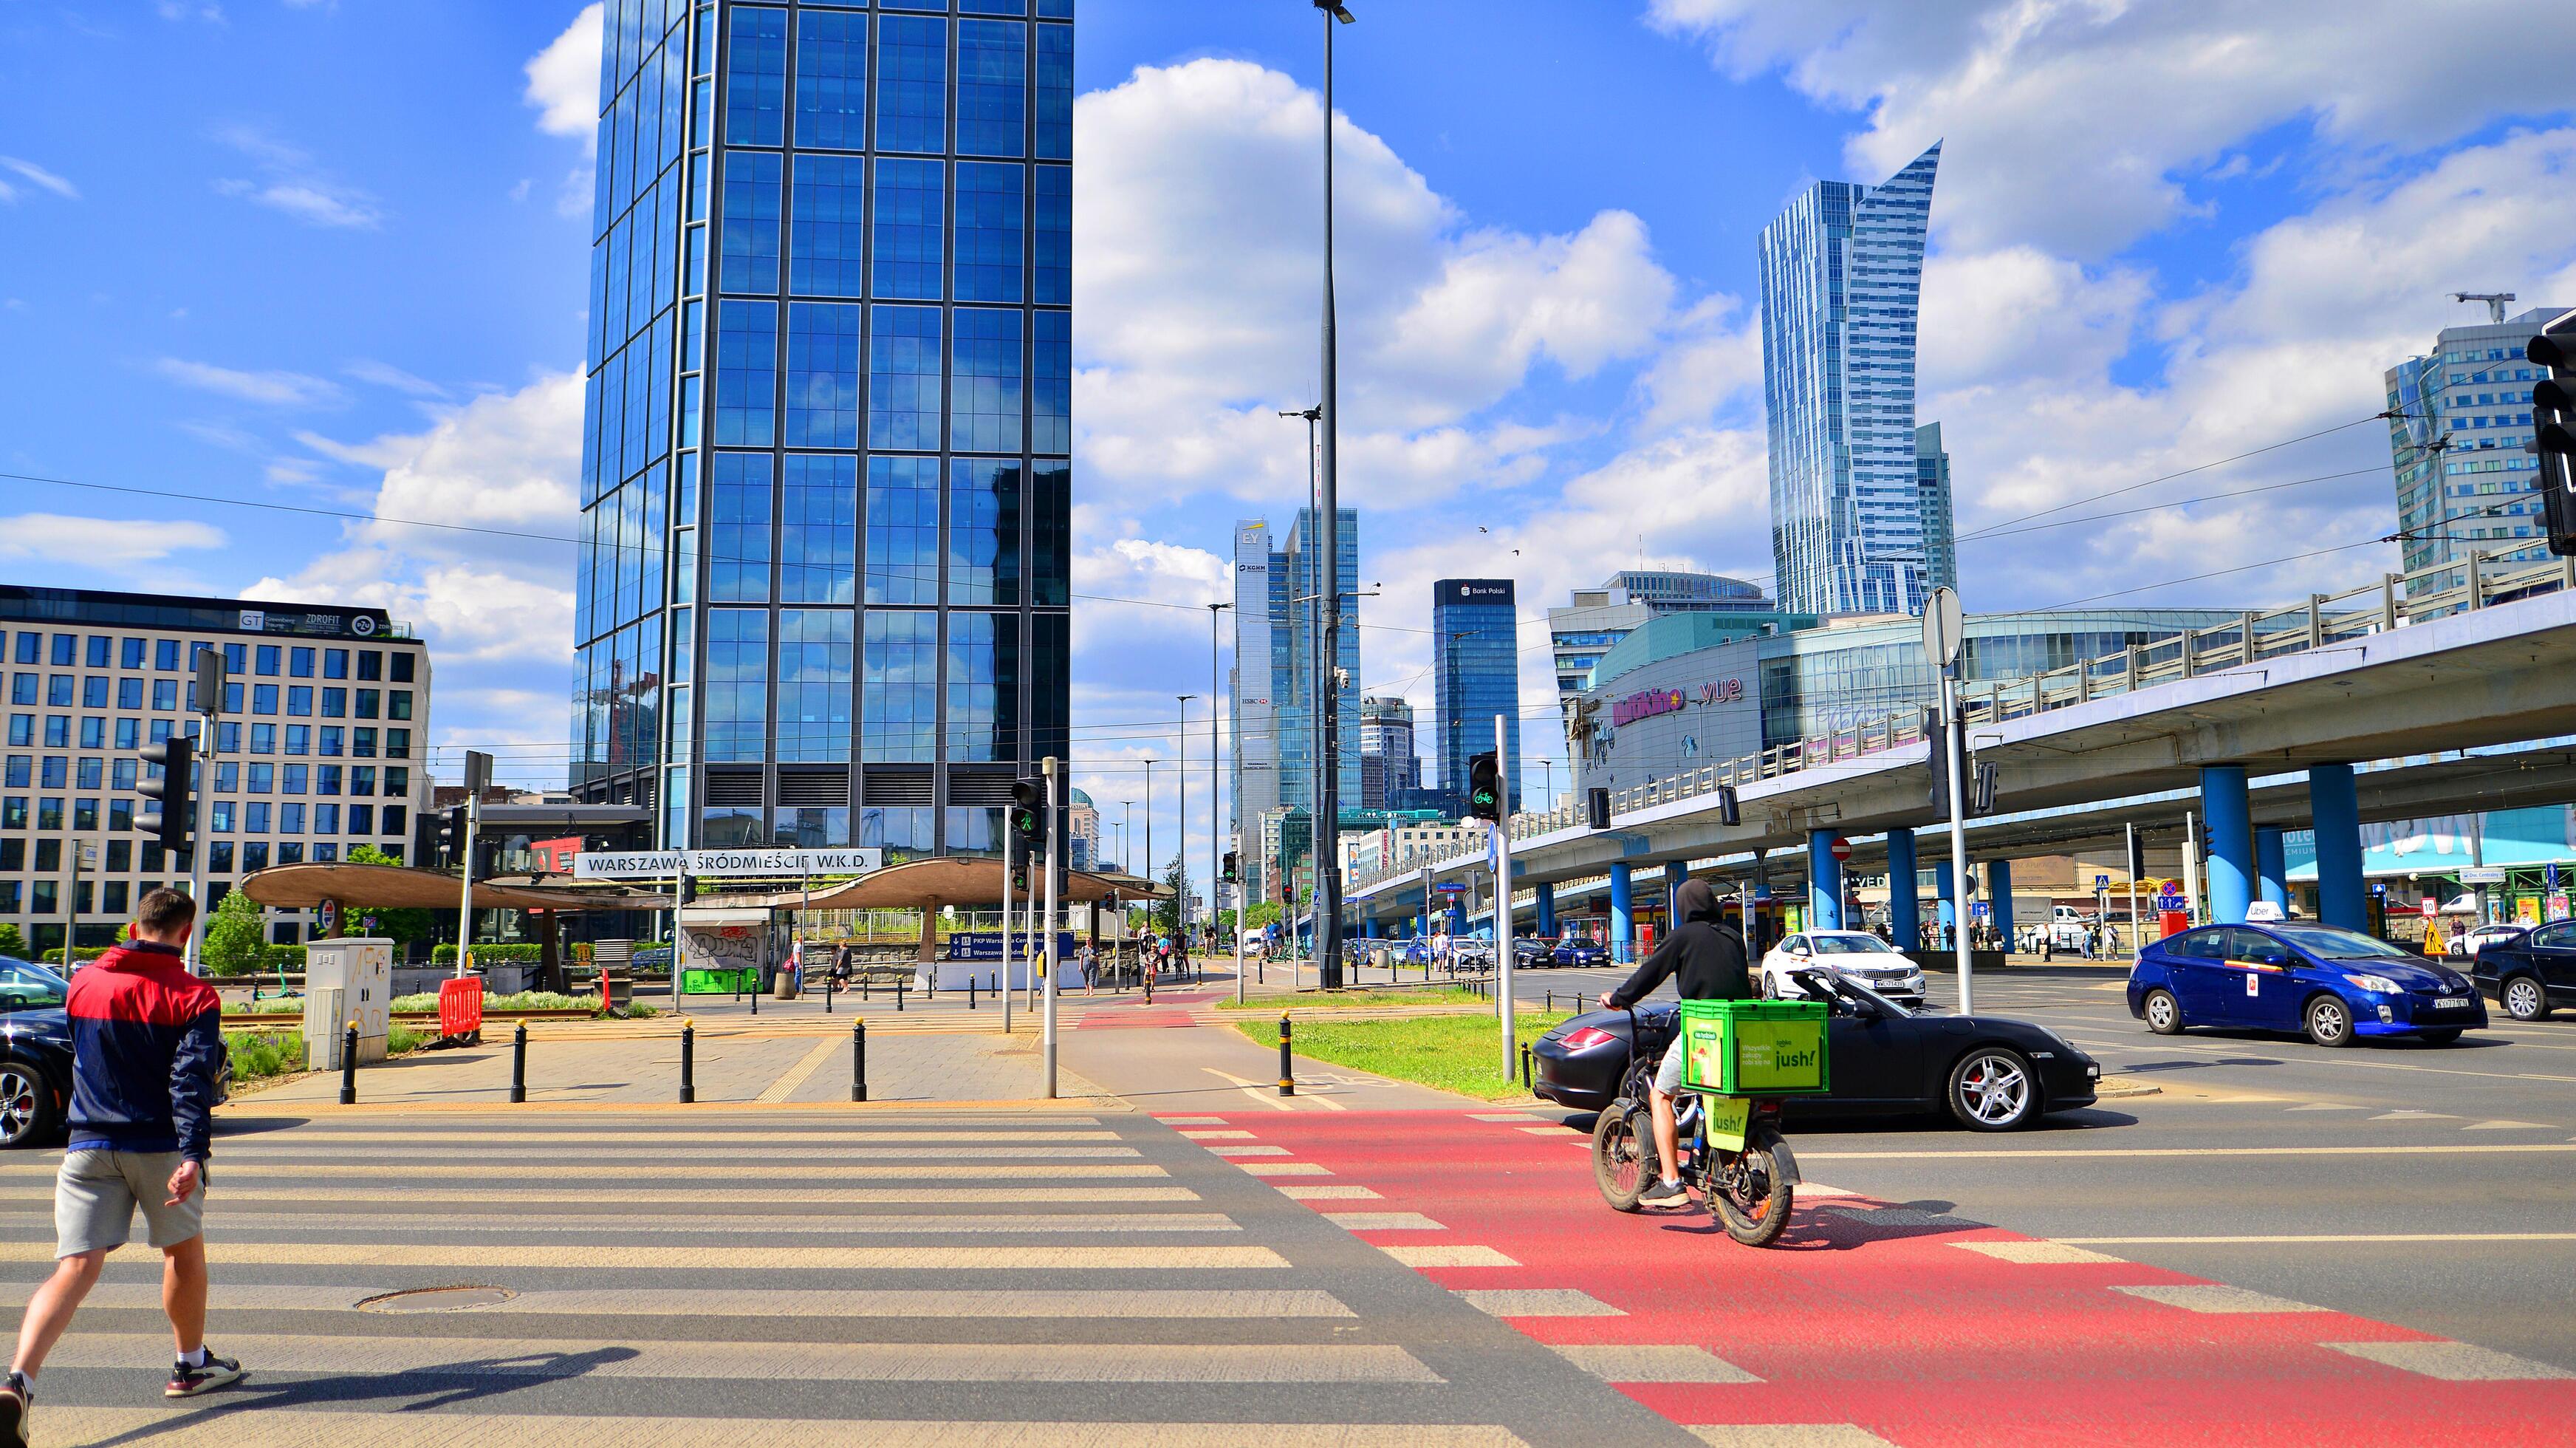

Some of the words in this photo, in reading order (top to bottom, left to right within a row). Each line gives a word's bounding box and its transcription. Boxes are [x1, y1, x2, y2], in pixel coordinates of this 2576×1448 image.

[1242, 533, 1259, 544] EY
[242, 615, 261, 626] GT
[306, 614, 340, 624] ZDROFIT
[1699, 677, 1741, 703] vue
[1613, 688, 1685, 727] Multikino
[589, 857, 689, 871] WARSZAWA
[696, 852, 809, 870] ŚRÓDMIEŚCIE
[817, 854, 868, 867] W.K.D.
[2250, 907, 2269, 915] Uber
[2425, 903, 2433, 911] 10
[1776, 1051, 1816, 1071] jush!
